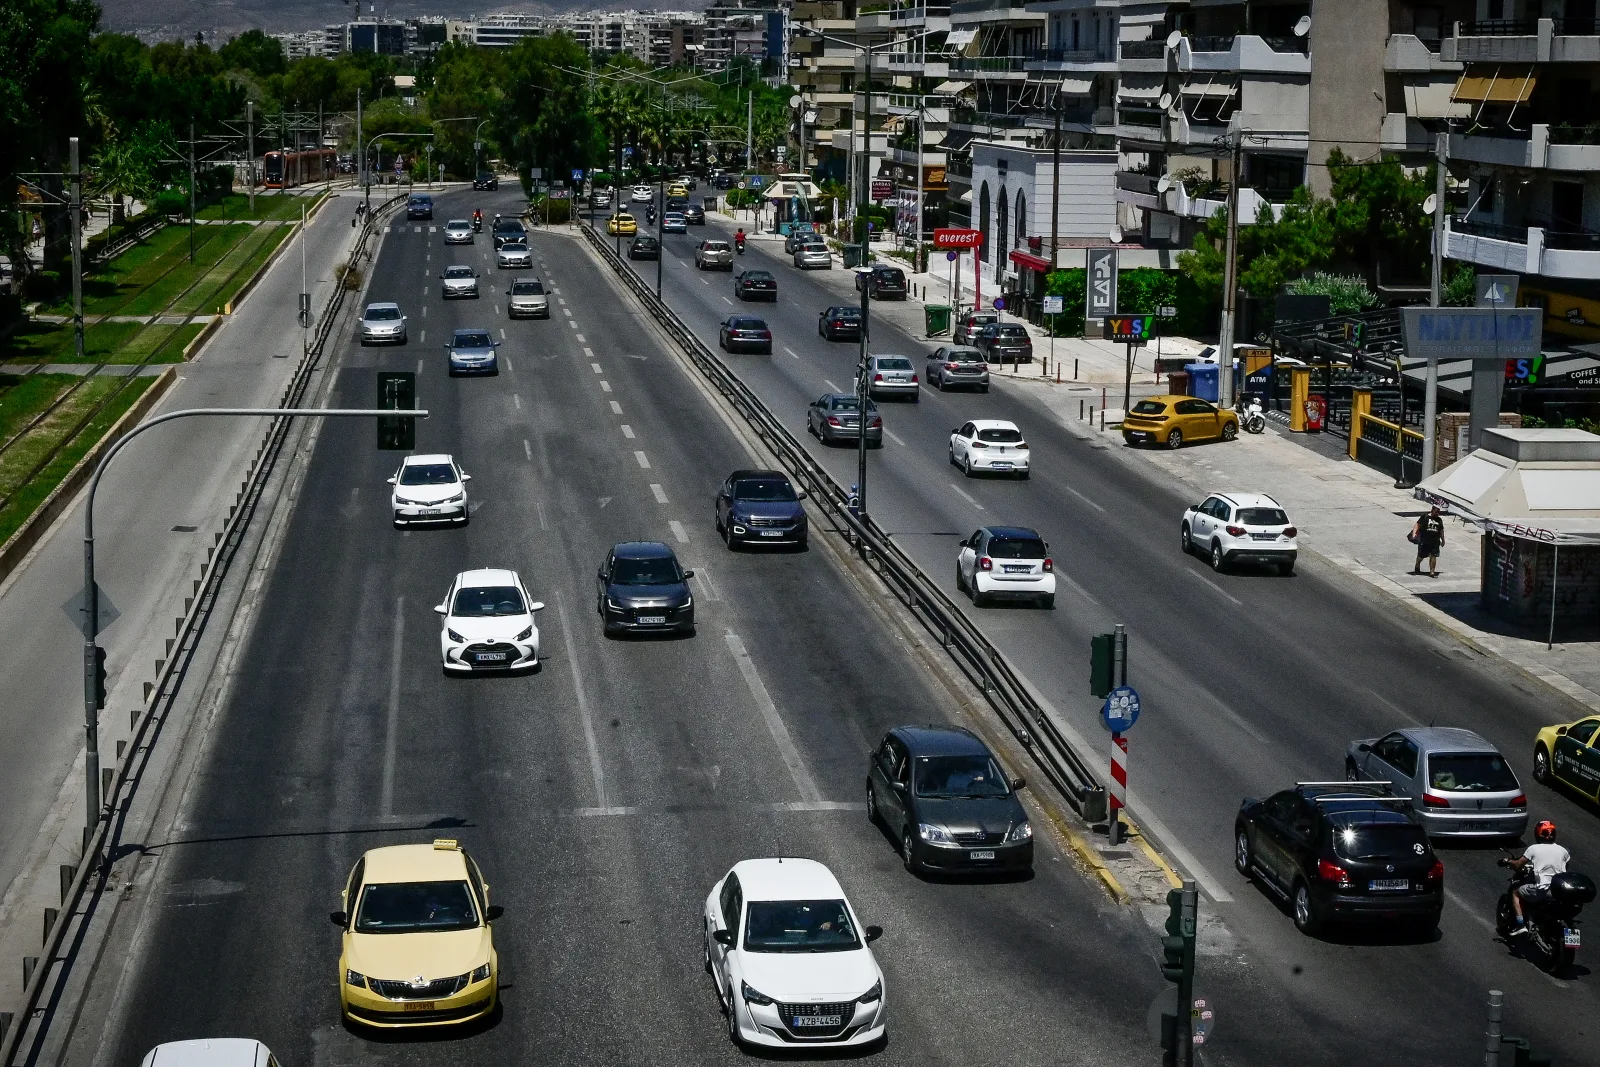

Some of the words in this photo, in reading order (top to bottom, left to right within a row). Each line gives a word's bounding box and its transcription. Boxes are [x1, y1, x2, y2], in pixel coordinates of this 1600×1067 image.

[939, 232, 978, 243] everest
[1110, 317, 1153, 338] YES!
[1571, 368, 1597, 379] COFFEE
[1578, 377, 1593, 385] and
[801, 1017, 840, 1026] XZB-4456
